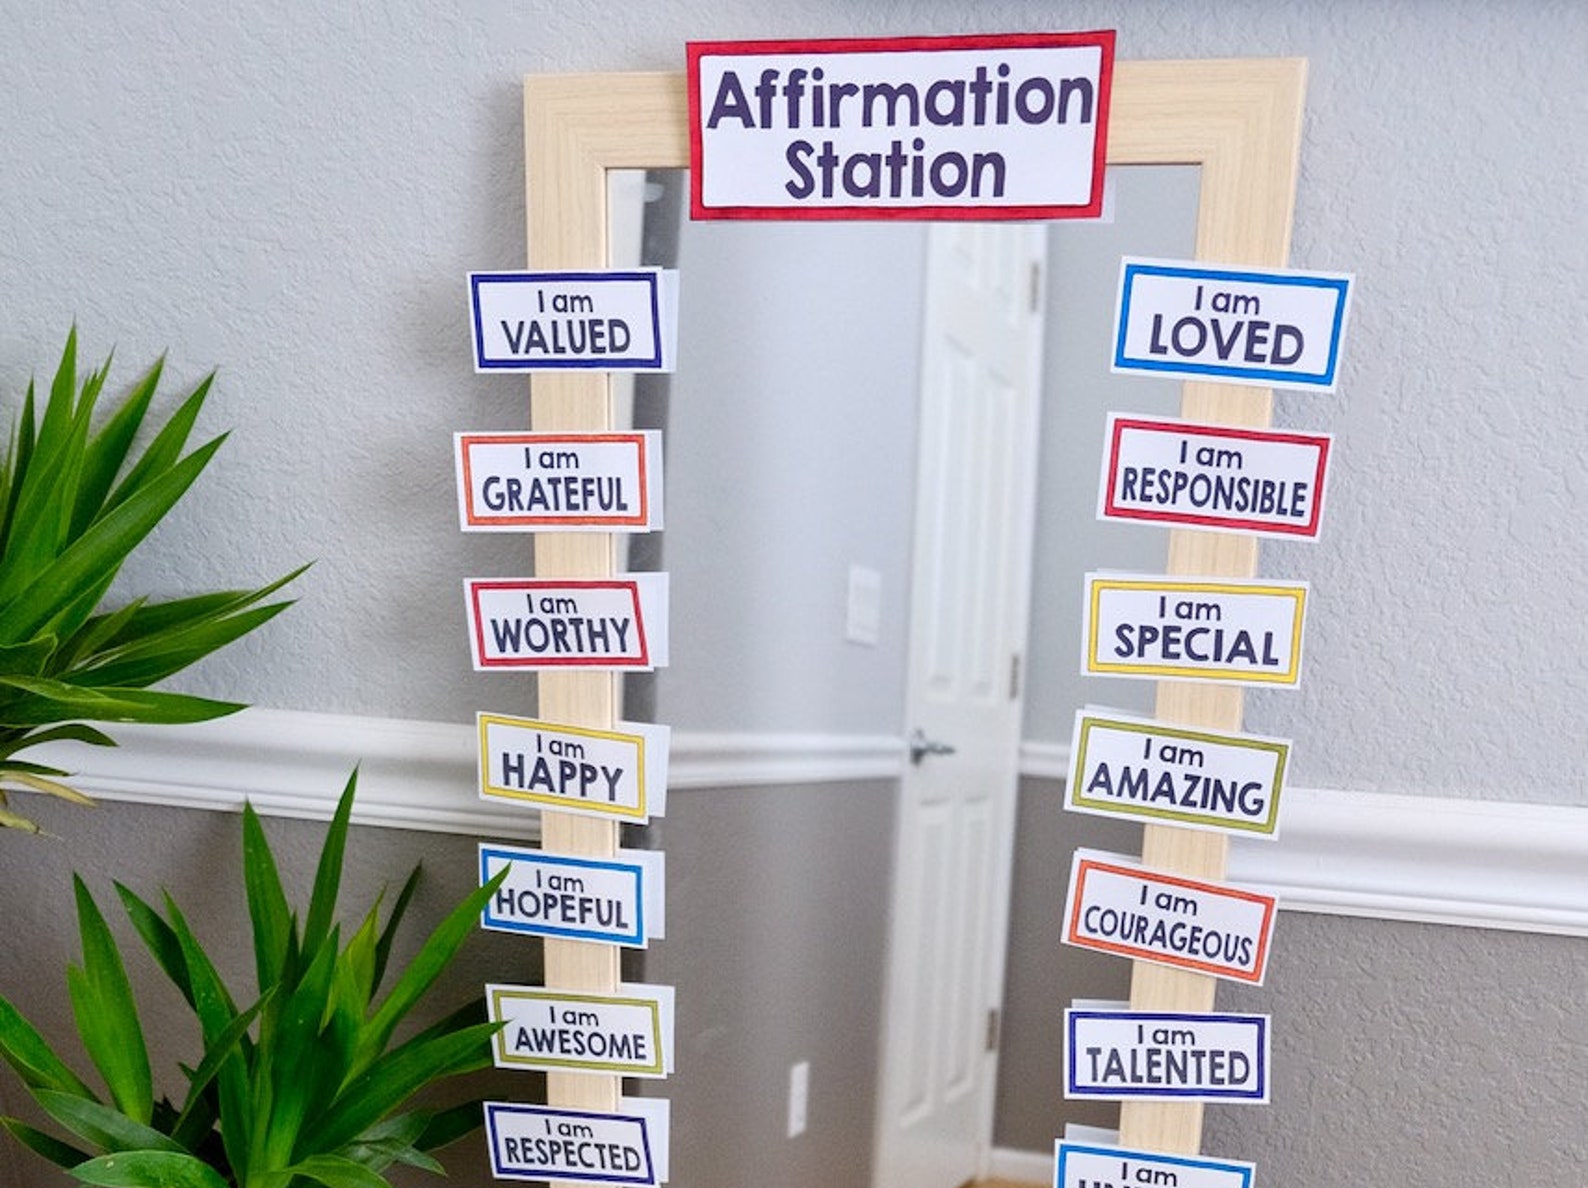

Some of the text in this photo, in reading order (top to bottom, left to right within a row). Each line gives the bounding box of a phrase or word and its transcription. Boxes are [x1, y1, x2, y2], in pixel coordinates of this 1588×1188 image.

[706, 63, 1093, 129] Affirmation
[785, 137, 1006, 199] Station
[537, 289, 593, 314] I am
[1194, 285, 1260, 315] I am
[500, 319, 630, 354] VALUED
[1149, 314, 1304, 366] LOVED
[524, 446, 579, 470] I am
[1179, 439, 1242, 470] I am
[483, 476, 628, 512] GRATEFUL
[1122, 467, 1307, 518] RESPONSIBLE
[526, 593, 578, 615] I am
[1158, 595, 1221, 621] I am
[490, 618, 630, 653] WORTHY
[1114, 623, 1279, 666] SPECIAL
[536, 733, 584, 759] I am
[1143, 737, 1204, 768] I am
[502, 752, 623, 801] HAPPY
[1087, 762, 1264, 816] AMAZING
[535, 868, 584, 893] I am
[496, 888, 628, 929] HOPEFUL
[1139, 884, 1197, 916] I am
[1085, 905, 1253, 966] COURAGEOUS
[549, 1005, 599, 1027] I am
[515, 1027, 646, 1060] AWESOME
[1137, 1023, 1195, 1046] I am
[1086, 1047, 1250, 1085] TALENTED
[544, 1118, 593, 1138] I am
[505, 1137, 640, 1171] RESPECTED
[1121, 1161, 1177, 1187] I am
